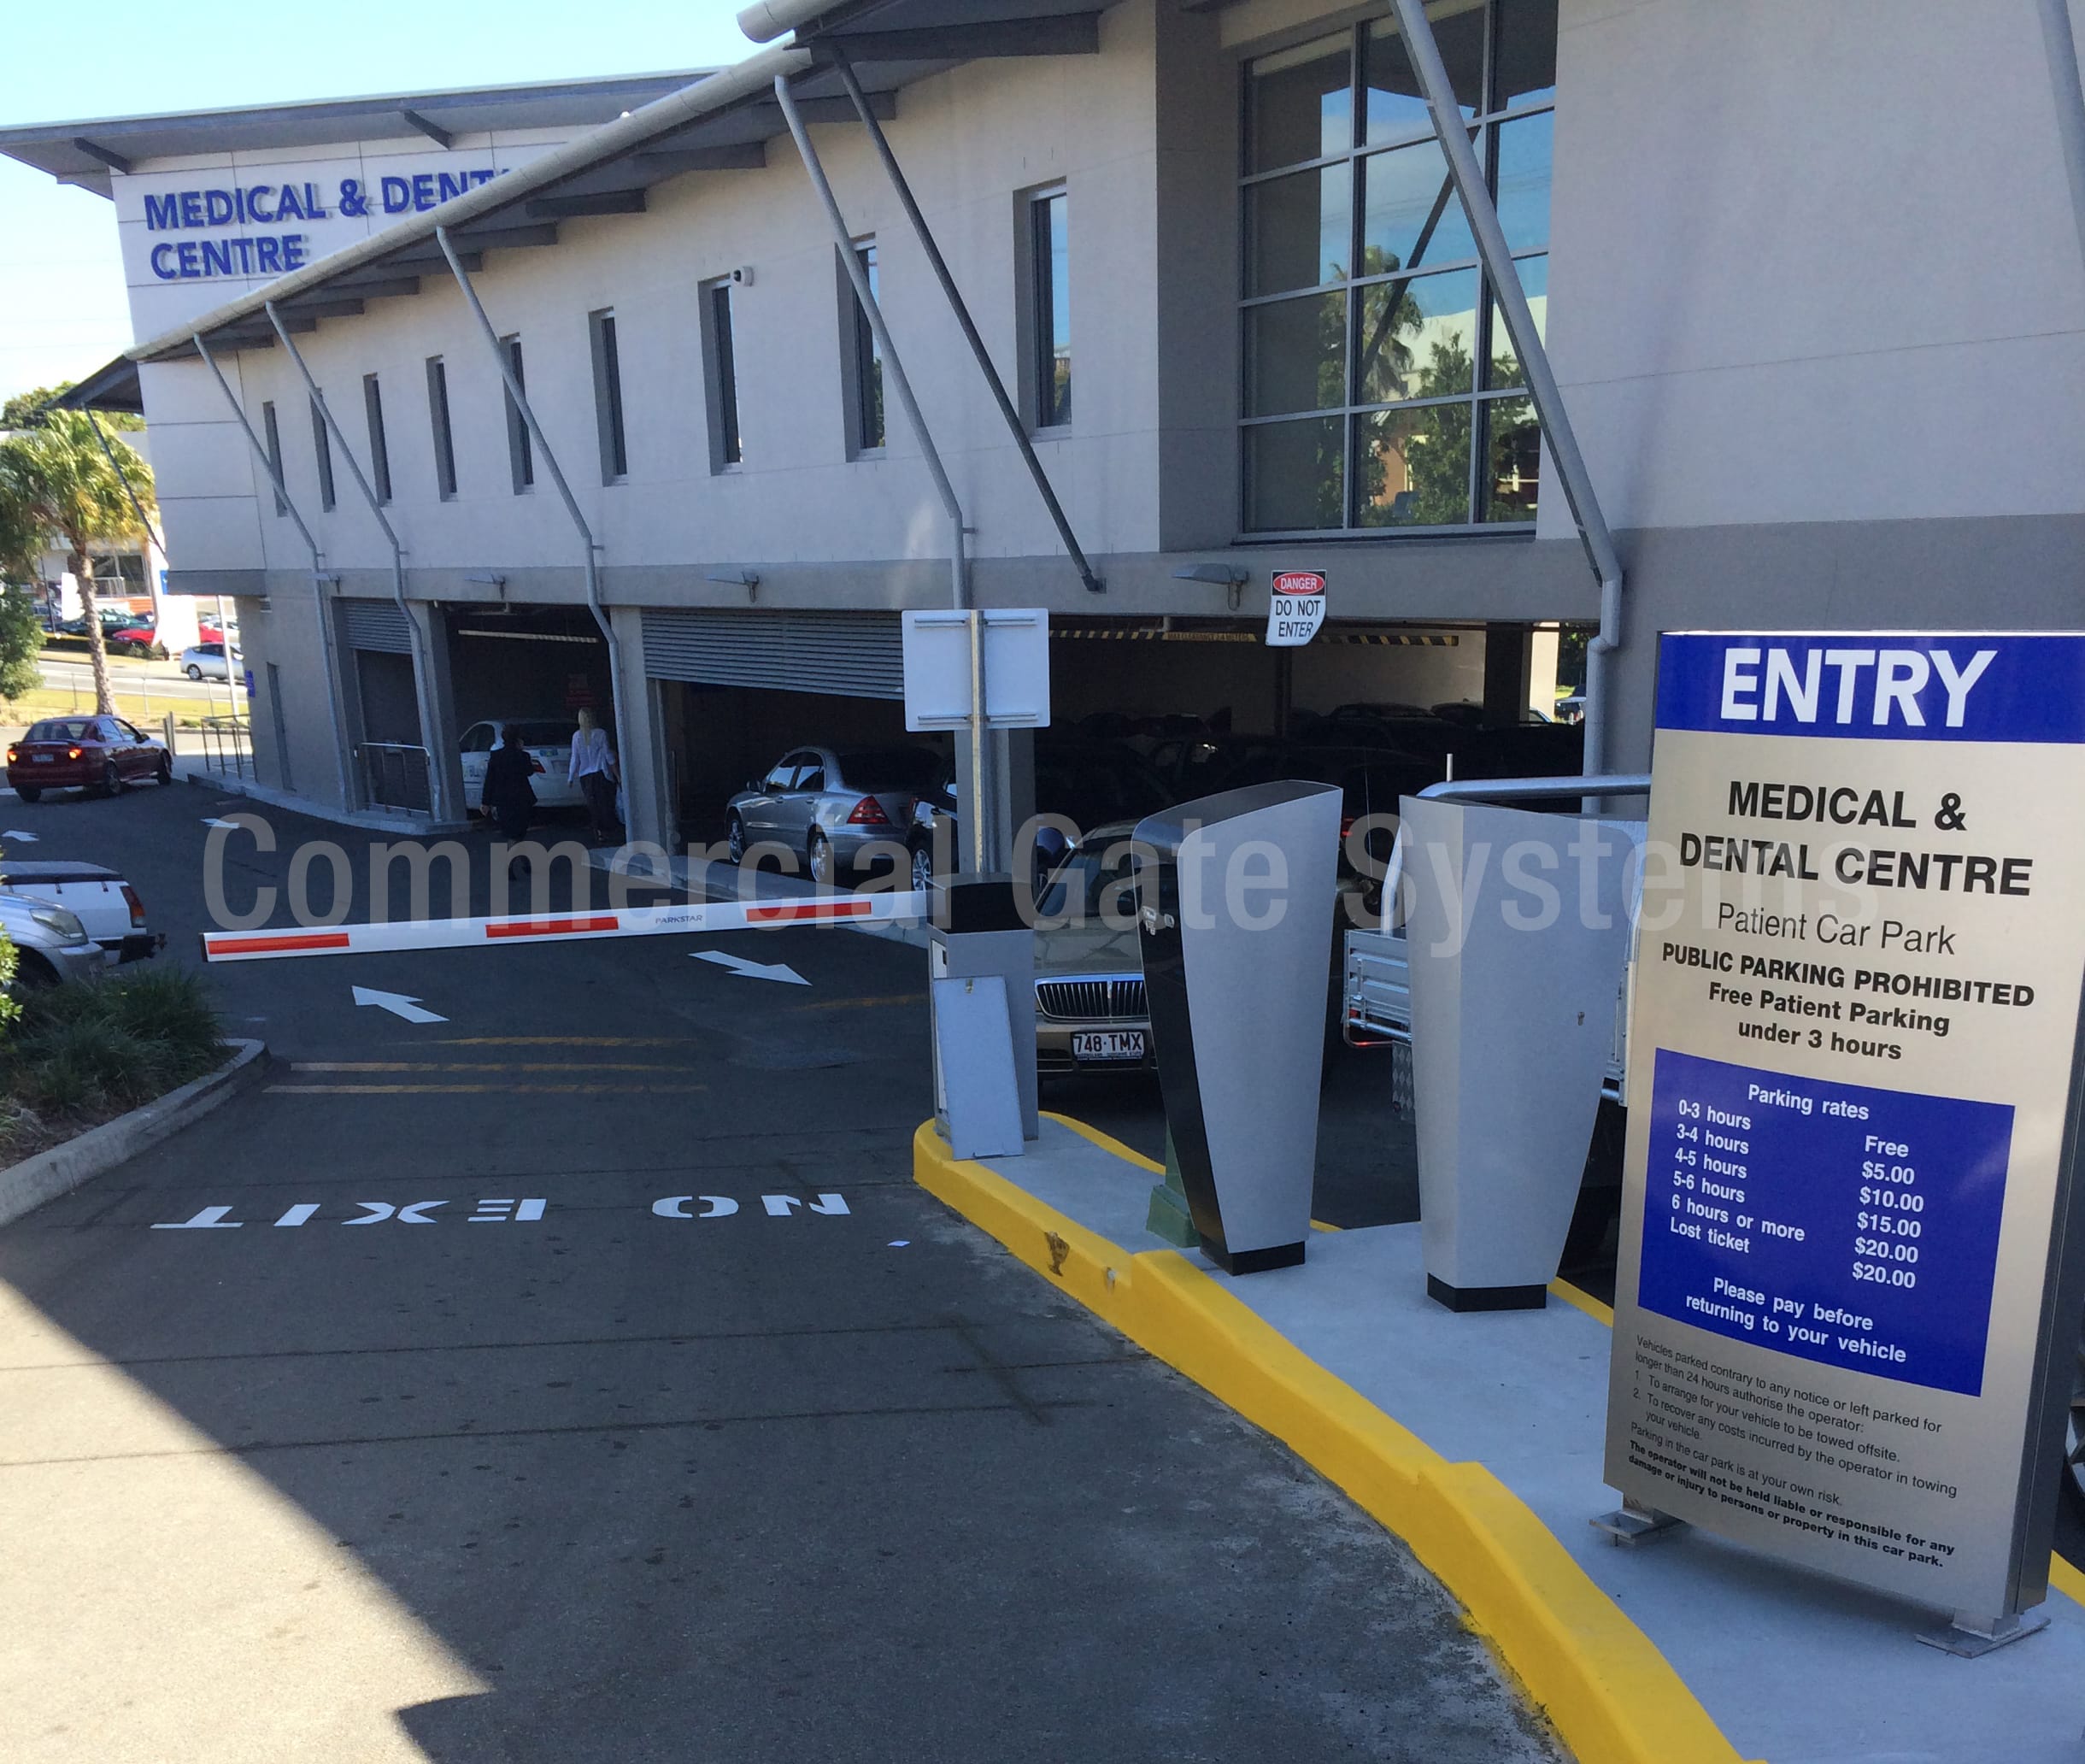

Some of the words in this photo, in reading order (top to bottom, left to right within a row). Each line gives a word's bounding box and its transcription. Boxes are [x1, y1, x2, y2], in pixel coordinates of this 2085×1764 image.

[144, 182, 326, 231] MEDICAL
[338, 179, 368, 218] &
[381, 168, 510, 215] DENT
[150, 234, 306, 280] CENTRE
[1275, 600, 1292, 616] DO
[1297, 600, 1321, 616] NOT
[1280, 577, 1318, 590] DANGER
[1278, 621, 1313, 638] ENTER
[1721, 648, 1998, 727] ENTRY
[1729, 781, 1916, 828] MEDICAL
[1935, 792, 1967, 831] &
[1680, 832, 1818, 880] DENTAL
[1835, 848, 2033, 896] CENTRE
[655, 914, 703, 924] PARKSTAR
[1718, 902, 1807, 940] Patient
[1817, 914, 1871, 946] Car
[1882, 920, 1955, 955] Park
[1663, 942, 1733, 972] PUBLIC
[1740, 955, 1844, 988] PARKING
[1854, 969, 2035, 1007] PROHIBITED
[1709, 981, 1753, 1007] Free
[1760, 990, 1841, 1020] Patient
[1849, 1002, 1949, 1037] Parking
[1739, 1022, 1800, 1044] under
[1808, 1029, 1822, 1049] 3
[1831, 1032, 1901, 1060] hours
[1679, 1099, 1700, 1119] 0-3
[1707, 1105, 1751, 1130] hours
[1865, 1135, 1909, 1157] Free
[1748, 1084, 1812, 1115] Parking
[1822, 1101, 1869, 1120] rates
[1675, 1147, 1696, 1166] 4-5
[1703, 1154, 1747, 1179] hours
[1859, 1186, 1923, 1212] $10.00
[1677, 1123, 1698, 1142] 3-4
[1705, 1130, 1749, 1155] hours
[1862, 1161, 1915, 1185] $5.00
[150, 1198, 547, 1229] EXIT
[652, 1193, 852, 1219] NO
[1672, 1194, 1680, 1209] 6
[1687, 1197, 1729, 1223] hours
[1736, 1214, 1753, 1229] or
[1762, 1220, 1805, 1241] more
[1854, 1237, 1918, 1263] $20.00
[1673, 1170, 1694, 1190] 5-6
[1701, 1178, 1745, 1202] hours
[1857, 1211, 1921, 1238] $15.00
[1671, 1216, 1701, 1239] Lost
[1707, 1228, 1750, 1253] ticket
[1853, 1261, 1916, 1288] $20.00
[1686, 1296, 1754, 1330] returning
[1763, 1315, 1779, 1333] to
[1788, 1325, 1829, 1345] your
[1838, 1337, 1906, 1362] vehicle
[1714, 1277, 1765, 1305] Please
[1773, 1297, 1805, 1319] pay
[1813, 1303, 1873, 1331] before
[1636, 1351, 1662, 1370] longer
[1665, 1363, 1684, 1379] than
[1686, 1371, 1698, 1384] 24
[1701, 1376, 1730, 1395] hours
[1732, 1389, 1783, 1411] authorise
[1787, 1403, 1805, 1417] the
[1808, 1411, 1864, 1432] operator:
[1637, 1334, 1673, 1358] Vehicles
[1675, 1352, 1708, 1371] parked
[1711, 1365, 1753, 1387] contrary
[1756, 1377, 1766, 1389] to
[1769, 1383, 1790, 1398] any
[1794, 1390, 1830, 1407] notice
[1833, 1400, 1847, 1410] or
[1850, 1402, 1869, 1417] left
[1872, 1410, 1919, 1428] parked
[1923, 1418, 1942, 1432] for
[1646, 1411, 1665, 1426] your
[1647, 1392, 1659, 1407] To
[1660, 1401, 1695, 1420] recover
[1698, 1415, 1716, 1431] any
[1718, 1423, 1746, 1439] costs
[1749, 1432, 1794, 1454] incurred
[1798, 1445, 1812, 1461] by
[1816, 1451, 1835, 1465] the
[1838, 1459, 1893, 1480] operator
[1896, 1474, 1907, 1485] in
[1912, 1476, 1957, 1499] towing
[1648, 1374, 1660, 1389] To
[1662, 1383, 1698, 1403] arrange
[1700, 1395, 1713, 1408] for
[1716, 1402, 1739, 1417] your
[1741, 1411, 1780, 1430] vehicle
[1784, 1422, 1794, 1434] to
[1798, 1425, 1813, 1439] be
[1817, 1432, 1853, 1450] towed
[1858, 1444, 1900, 1462] offsite.
[1631, 1421, 1663, 1447] Parking
[1665, 1439, 1673, 1449] in
[1676, 1442, 1691, 1455] the
[1693, 1450, 1709, 1462] car
[1711, 1457, 1734, 1472] park
[1736, 1463, 1745, 1476] is
[1747, 1470, 1759, 1481] at
[1761, 1474, 1787, 1489] your
[1790, 1484, 1814, 1497] own
[1629, 1455, 1662, 1476] damage
[1665, 1472, 1675, 1481] or
[1677, 1475, 1705, 1495] injury
[1707, 1487, 1718, 1498] to
[1721, 1494, 1764, 1515] persons
[1767, 1510, 1780, 1520] or
[1783, 1515, 1835, 1538] property
[1838, 1530, 1849, 1542] in
[1854, 1535, 1878, 1549] this
[1882, 1545, 1905, 1556] car
[1908, 1551, 1943, 1567] park.
[1630, 1439, 1645, 1455] The
[1647, 1450, 1687, 1472] operator
[1689, 1467, 1706, 1480] will
[1710, 1475, 1726, 1487] not
[1730, 1480, 1742, 1493] be
[1747, 1486, 1771, 1502] held
[1774, 1495, 1806, 1514] liable
[1810, 1509, 1823, 1518] or
[1826, 1514, 1901, 1541] responsible
[1906, 1533, 1926, 1547] for
[1929, 1542, 1955, 1555] any
